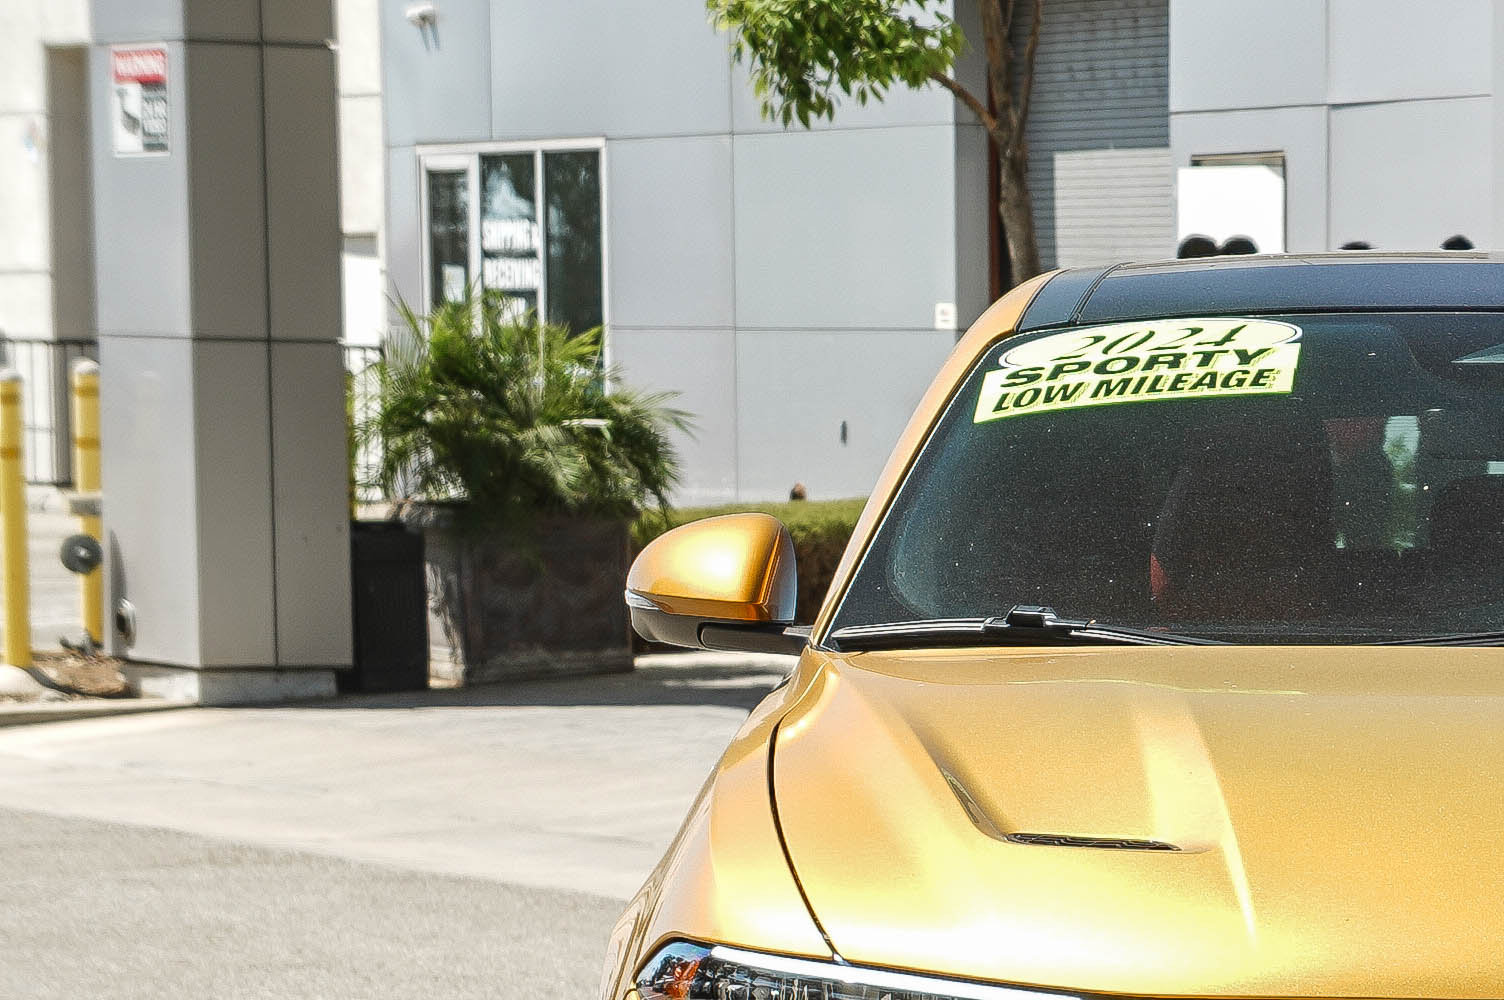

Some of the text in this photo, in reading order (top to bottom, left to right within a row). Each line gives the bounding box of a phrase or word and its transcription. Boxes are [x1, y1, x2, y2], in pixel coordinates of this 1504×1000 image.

[1000, 348, 1273, 388] SPORTY
[992, 368, 1280, 413] LOW MILEAGE
